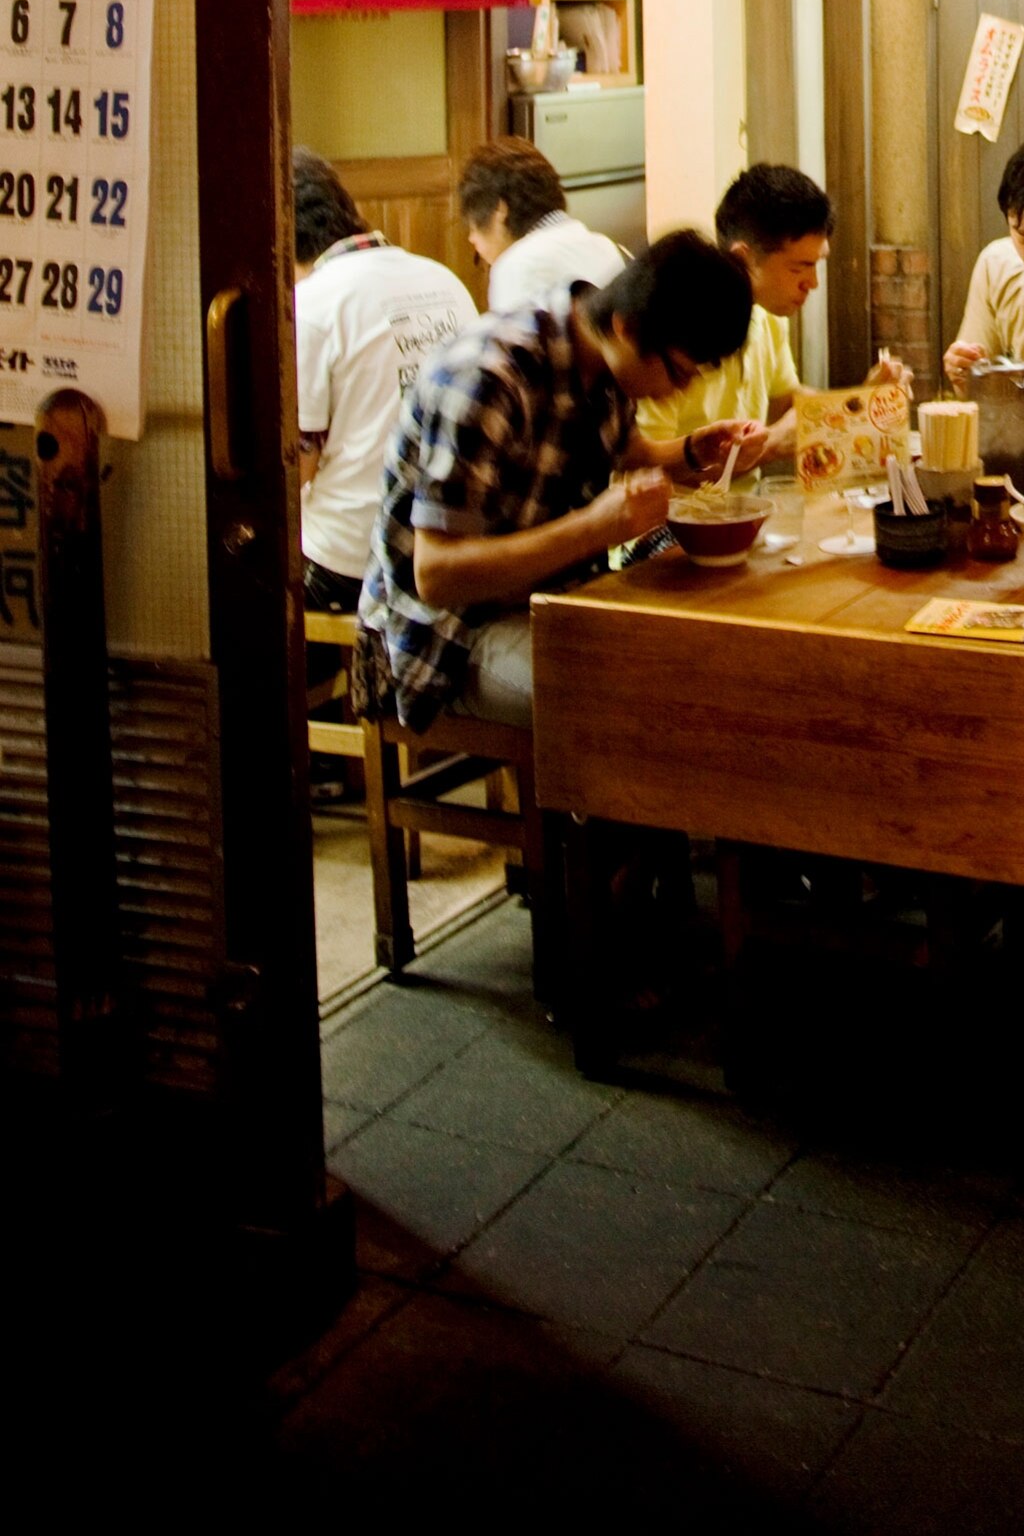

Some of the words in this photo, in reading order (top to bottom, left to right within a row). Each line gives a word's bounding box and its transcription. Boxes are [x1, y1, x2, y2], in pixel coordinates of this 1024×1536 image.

[59, 0, 78, 46] 7
[106, 1, 125, 49] 8
[1, 85, 36, 131] 13
[47, 87, 82, 135] 14
[94, 89, 130, 139] 15
[0, 171, 35, 218] 20
[46, 174, 79, 222] 21
[90, 179, 128, 226] 22
[0, 258, 33, 305] 27
[42, 262, 78, 310] 28
[87, 266, 123, 315] 29
